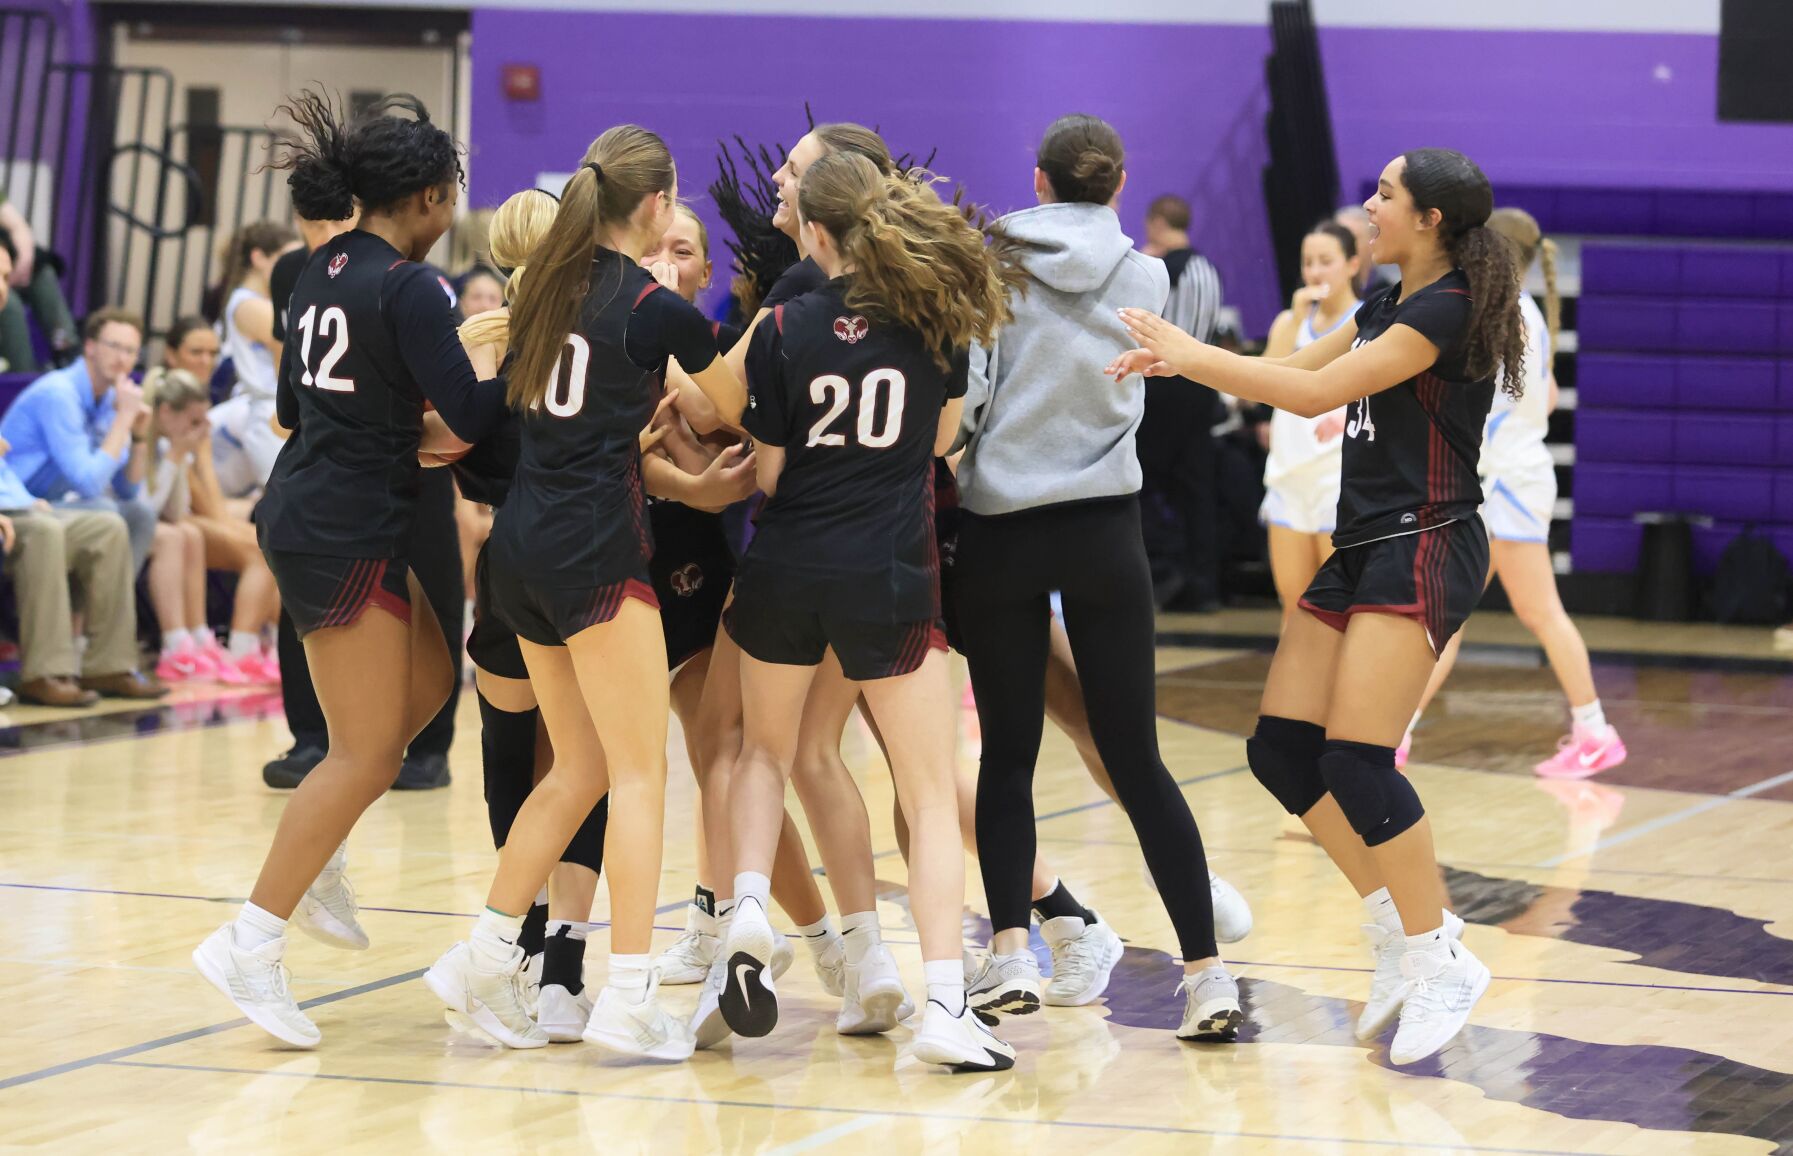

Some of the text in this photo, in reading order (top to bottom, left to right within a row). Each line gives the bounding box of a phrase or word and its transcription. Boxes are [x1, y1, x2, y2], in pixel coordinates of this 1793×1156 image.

[298, 304, 355, 392] 12
[529, 333, 590, 418] 0
[805, 367, 907, 449] 20
[1346, 394, 1376, 442] 34
